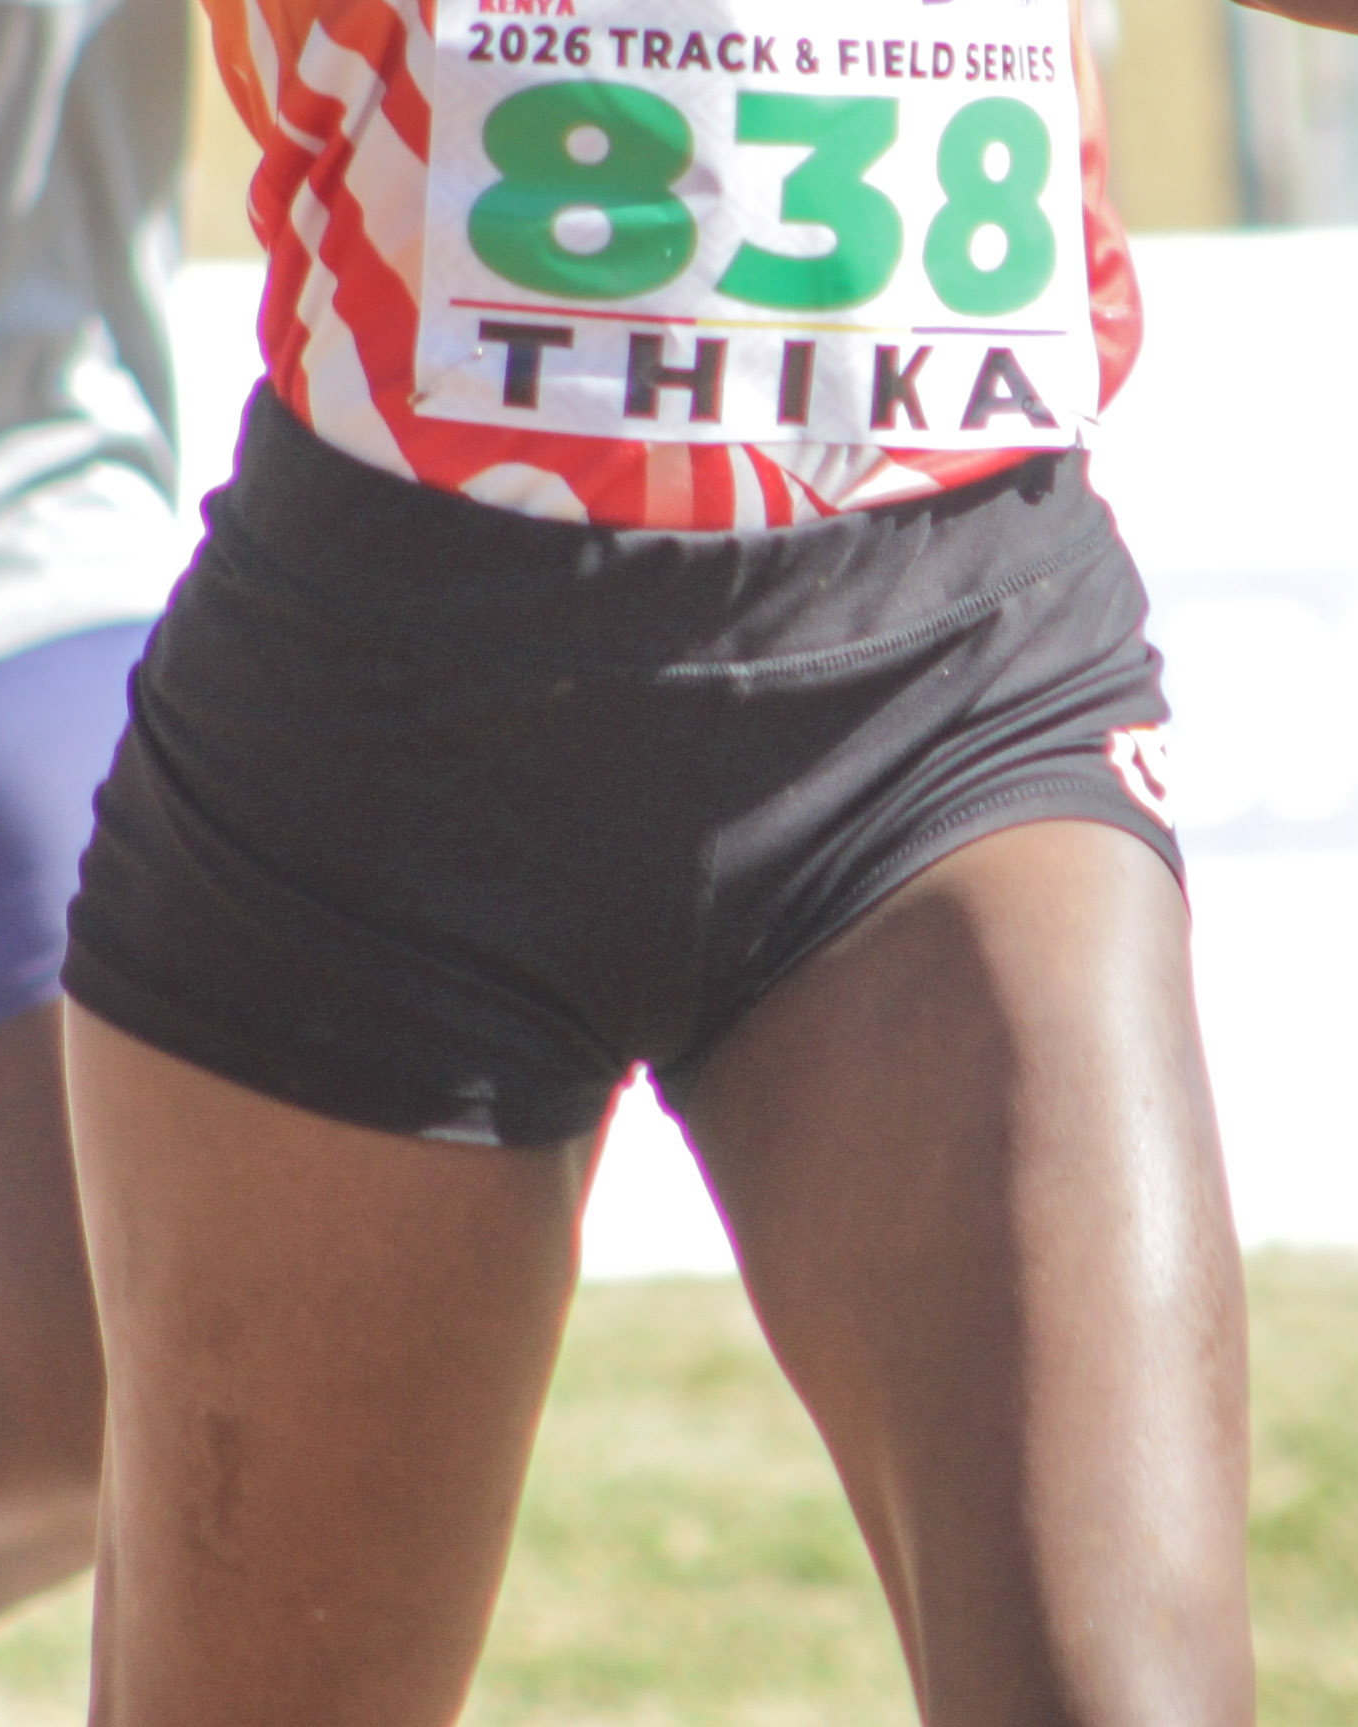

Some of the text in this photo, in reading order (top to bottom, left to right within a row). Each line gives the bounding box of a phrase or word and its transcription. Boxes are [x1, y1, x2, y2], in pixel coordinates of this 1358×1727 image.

[468, 22, 1055, 82] 2026 TRACK & FIELD SERIES
[467, 79, 1057, 318] 838
[477, 320, 1061, 432] THIKA
